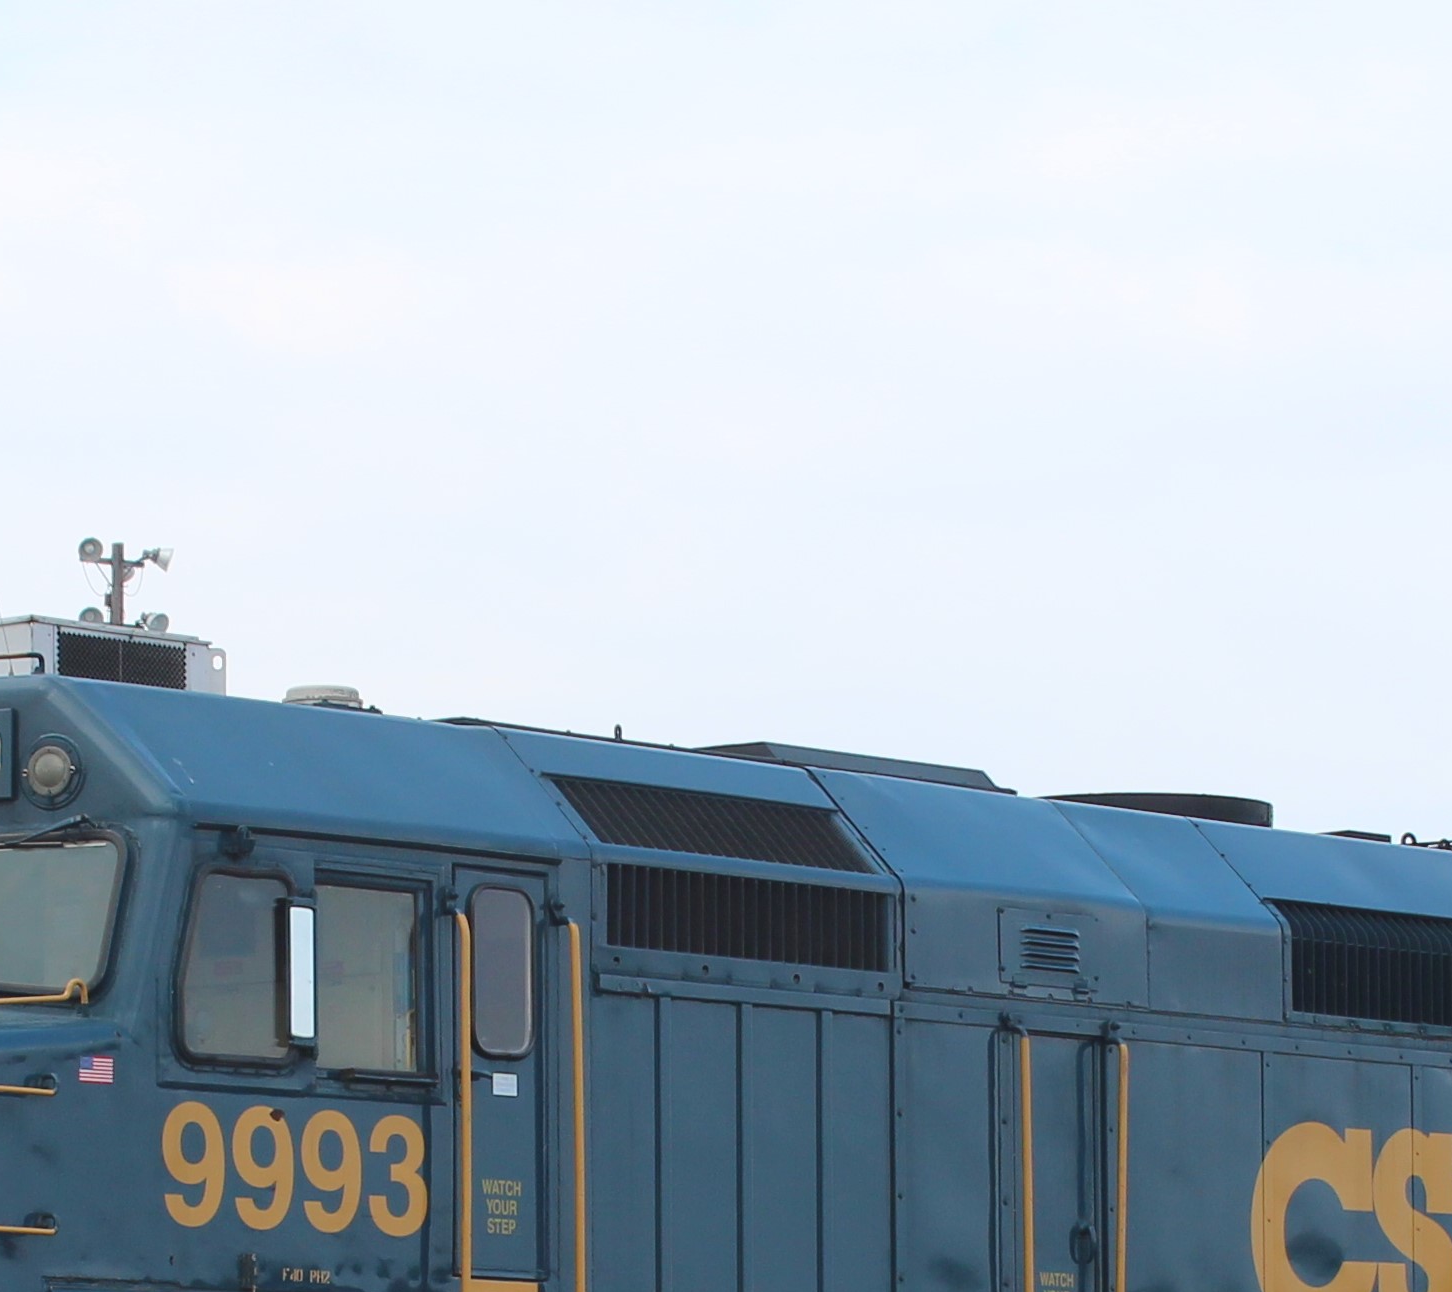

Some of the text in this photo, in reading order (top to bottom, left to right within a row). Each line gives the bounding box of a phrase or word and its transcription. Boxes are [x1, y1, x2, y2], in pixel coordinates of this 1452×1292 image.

[161, 1100, 428, 1238] 9993
[482, 1178, 522, 1197] WATCH
[486, 1198, 518, 1215] YOUR
[487, 1217, 516, 1235] STEP
[1039, 1271, 1074, 1288] WATCH
